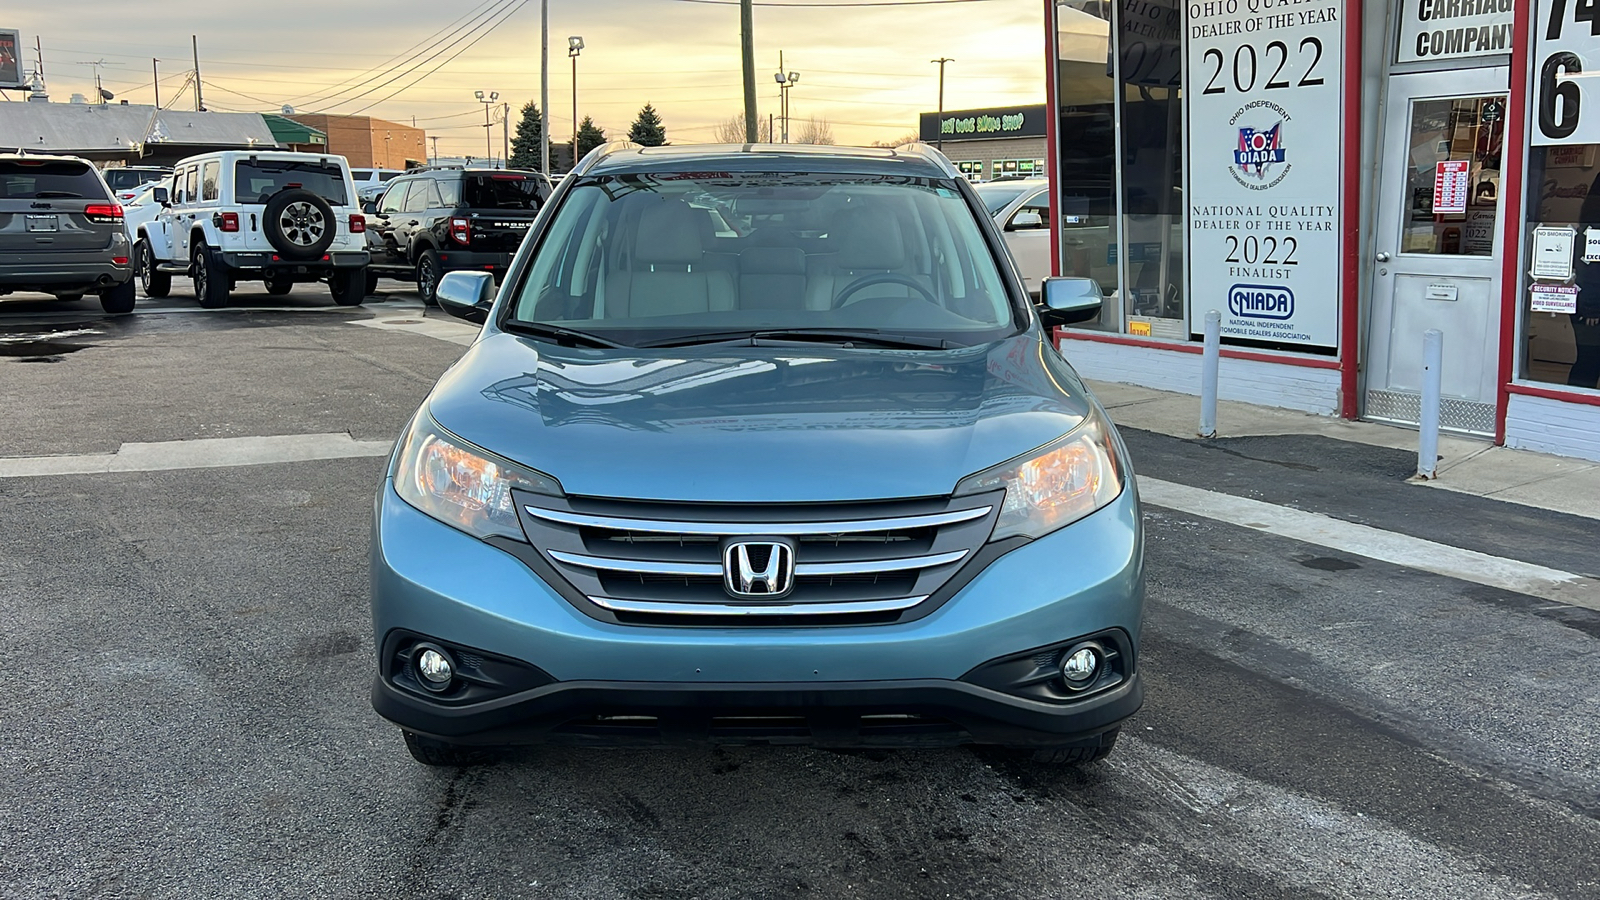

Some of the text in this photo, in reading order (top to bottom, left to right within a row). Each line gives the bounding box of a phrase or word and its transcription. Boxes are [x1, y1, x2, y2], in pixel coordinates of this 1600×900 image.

[1190, 0, 1238, 19] OHIO
[1418, 0, 1515, 21] CARRIAG
[1192, 20, 1242, 39] DEALER
[1245, 18, 1263, 32] OF
[1266, 13, 1295, 29] THE
[1298, 7, 1337, 25] YEAR
[1202, 36, 1325, 95] 2022
[1001, 112, 1024, 131] SHOP
[1229, 100, 1292, 126] OHIO INDEPENDENT
[1240, 150, 1277, 163] OIADA
[1228, 163, 1292, 191] AUTOMOBILE DEALERS ASSOCIATION
[1192, 206, 1335, 218] NATIONAL QUALITY
[1194, 220, 1333, 231] DEALER OF THE YEAR
[1224, 235, 1299, 265] 2022
[1229, 267, 1292, 279] FINALIST
[1534, 285, 1557, 293] SECURITY
[1233, 291, 1288, 313] NIADA
[1229, 319, 1294, 330] NATIONAL INDEPENDENT
[1248, 329, 1272, 337] DEALERS
[1272, 331, 1311, 341] ASSOCIATION
